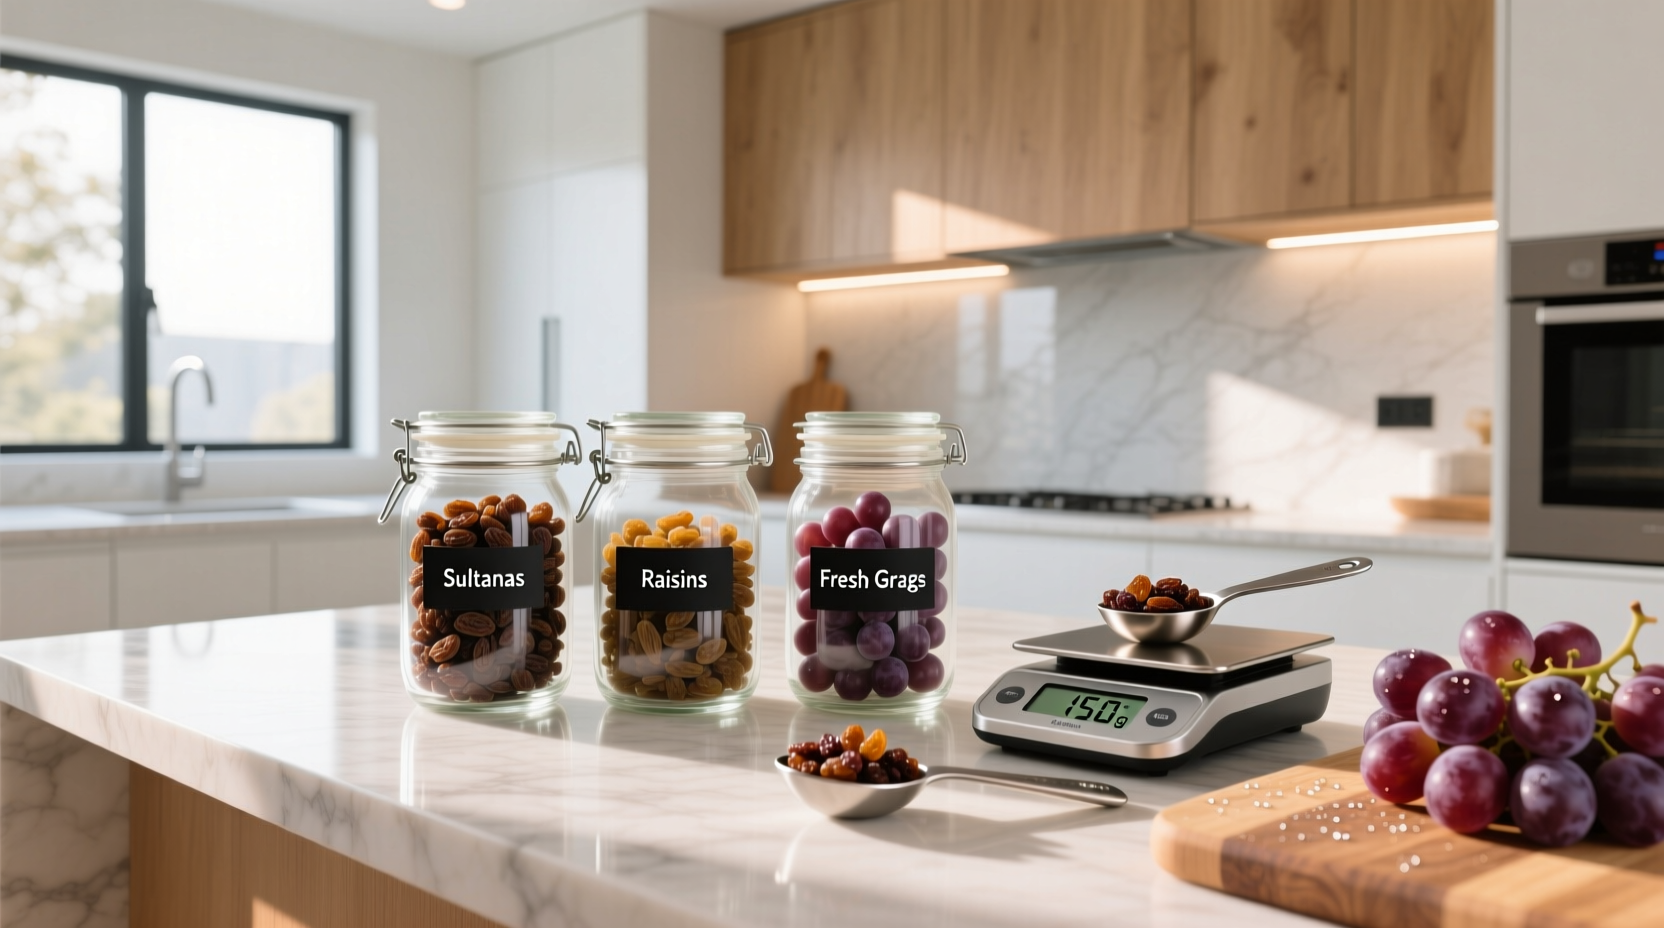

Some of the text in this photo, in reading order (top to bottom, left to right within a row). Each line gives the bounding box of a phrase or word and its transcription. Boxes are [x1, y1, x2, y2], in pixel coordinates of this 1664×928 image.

[443, 567, 525, 588] Sultanas
[641, 568, 708, 588] Raisins
[820, 568, 926, 593] Fresh Grags
